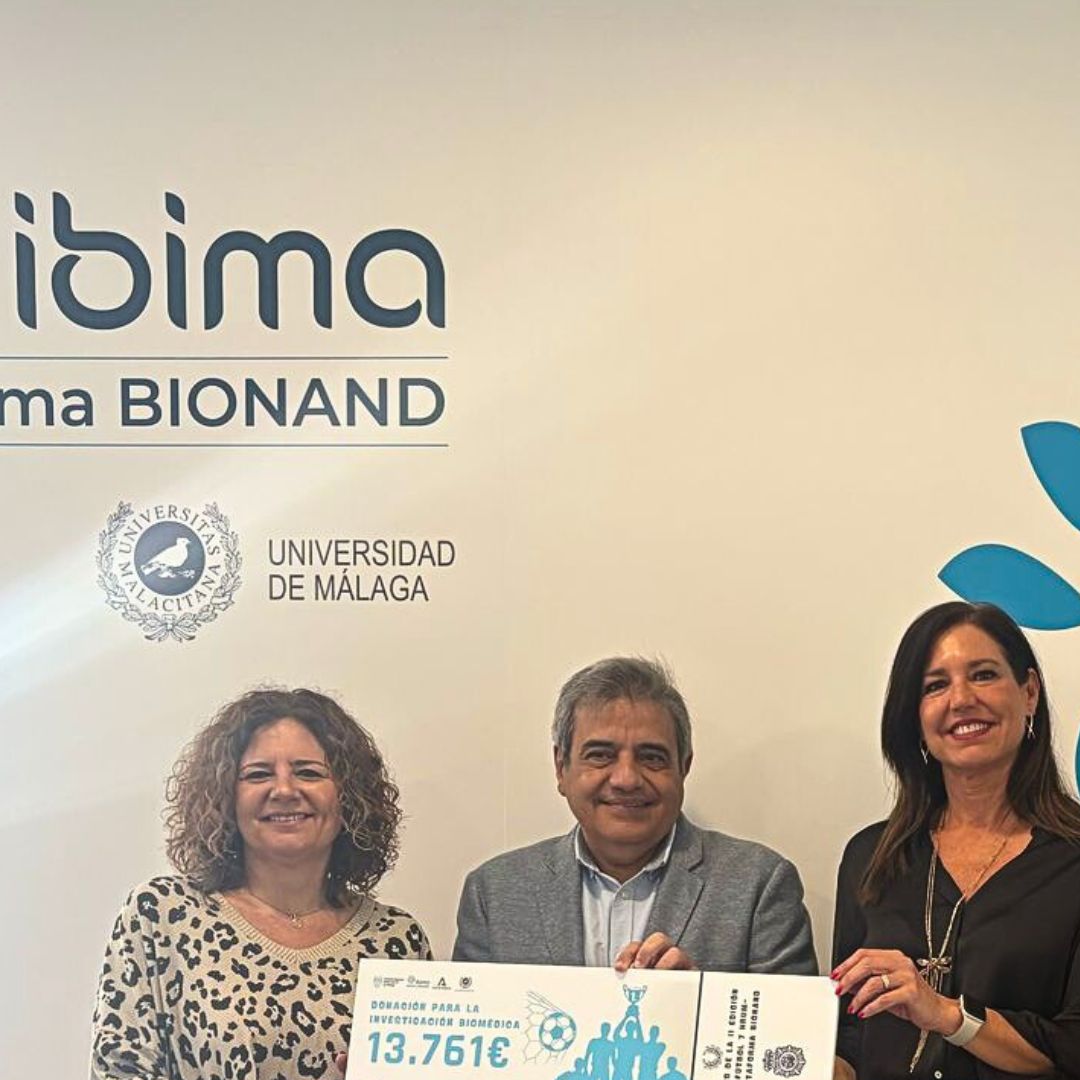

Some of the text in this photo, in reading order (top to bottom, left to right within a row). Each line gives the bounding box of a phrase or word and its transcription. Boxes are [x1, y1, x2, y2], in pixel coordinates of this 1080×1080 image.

[15, 191, 446, 330] ibima
[120, 377, 446, 427] BIONAND
[118, 504, 221, 556] UNIVERSITAS
[268, 539, 456, 567] UNIVERSIDAD
[118, 561, 221, 612] MALACITANA
[269, 568, 430, 602] DE MÁLAGA
[431, 1002, 461, 1012] PARA
[466, 1004, 480, 1013] LA
[368, 1031, 511, 1069] 13.761€
